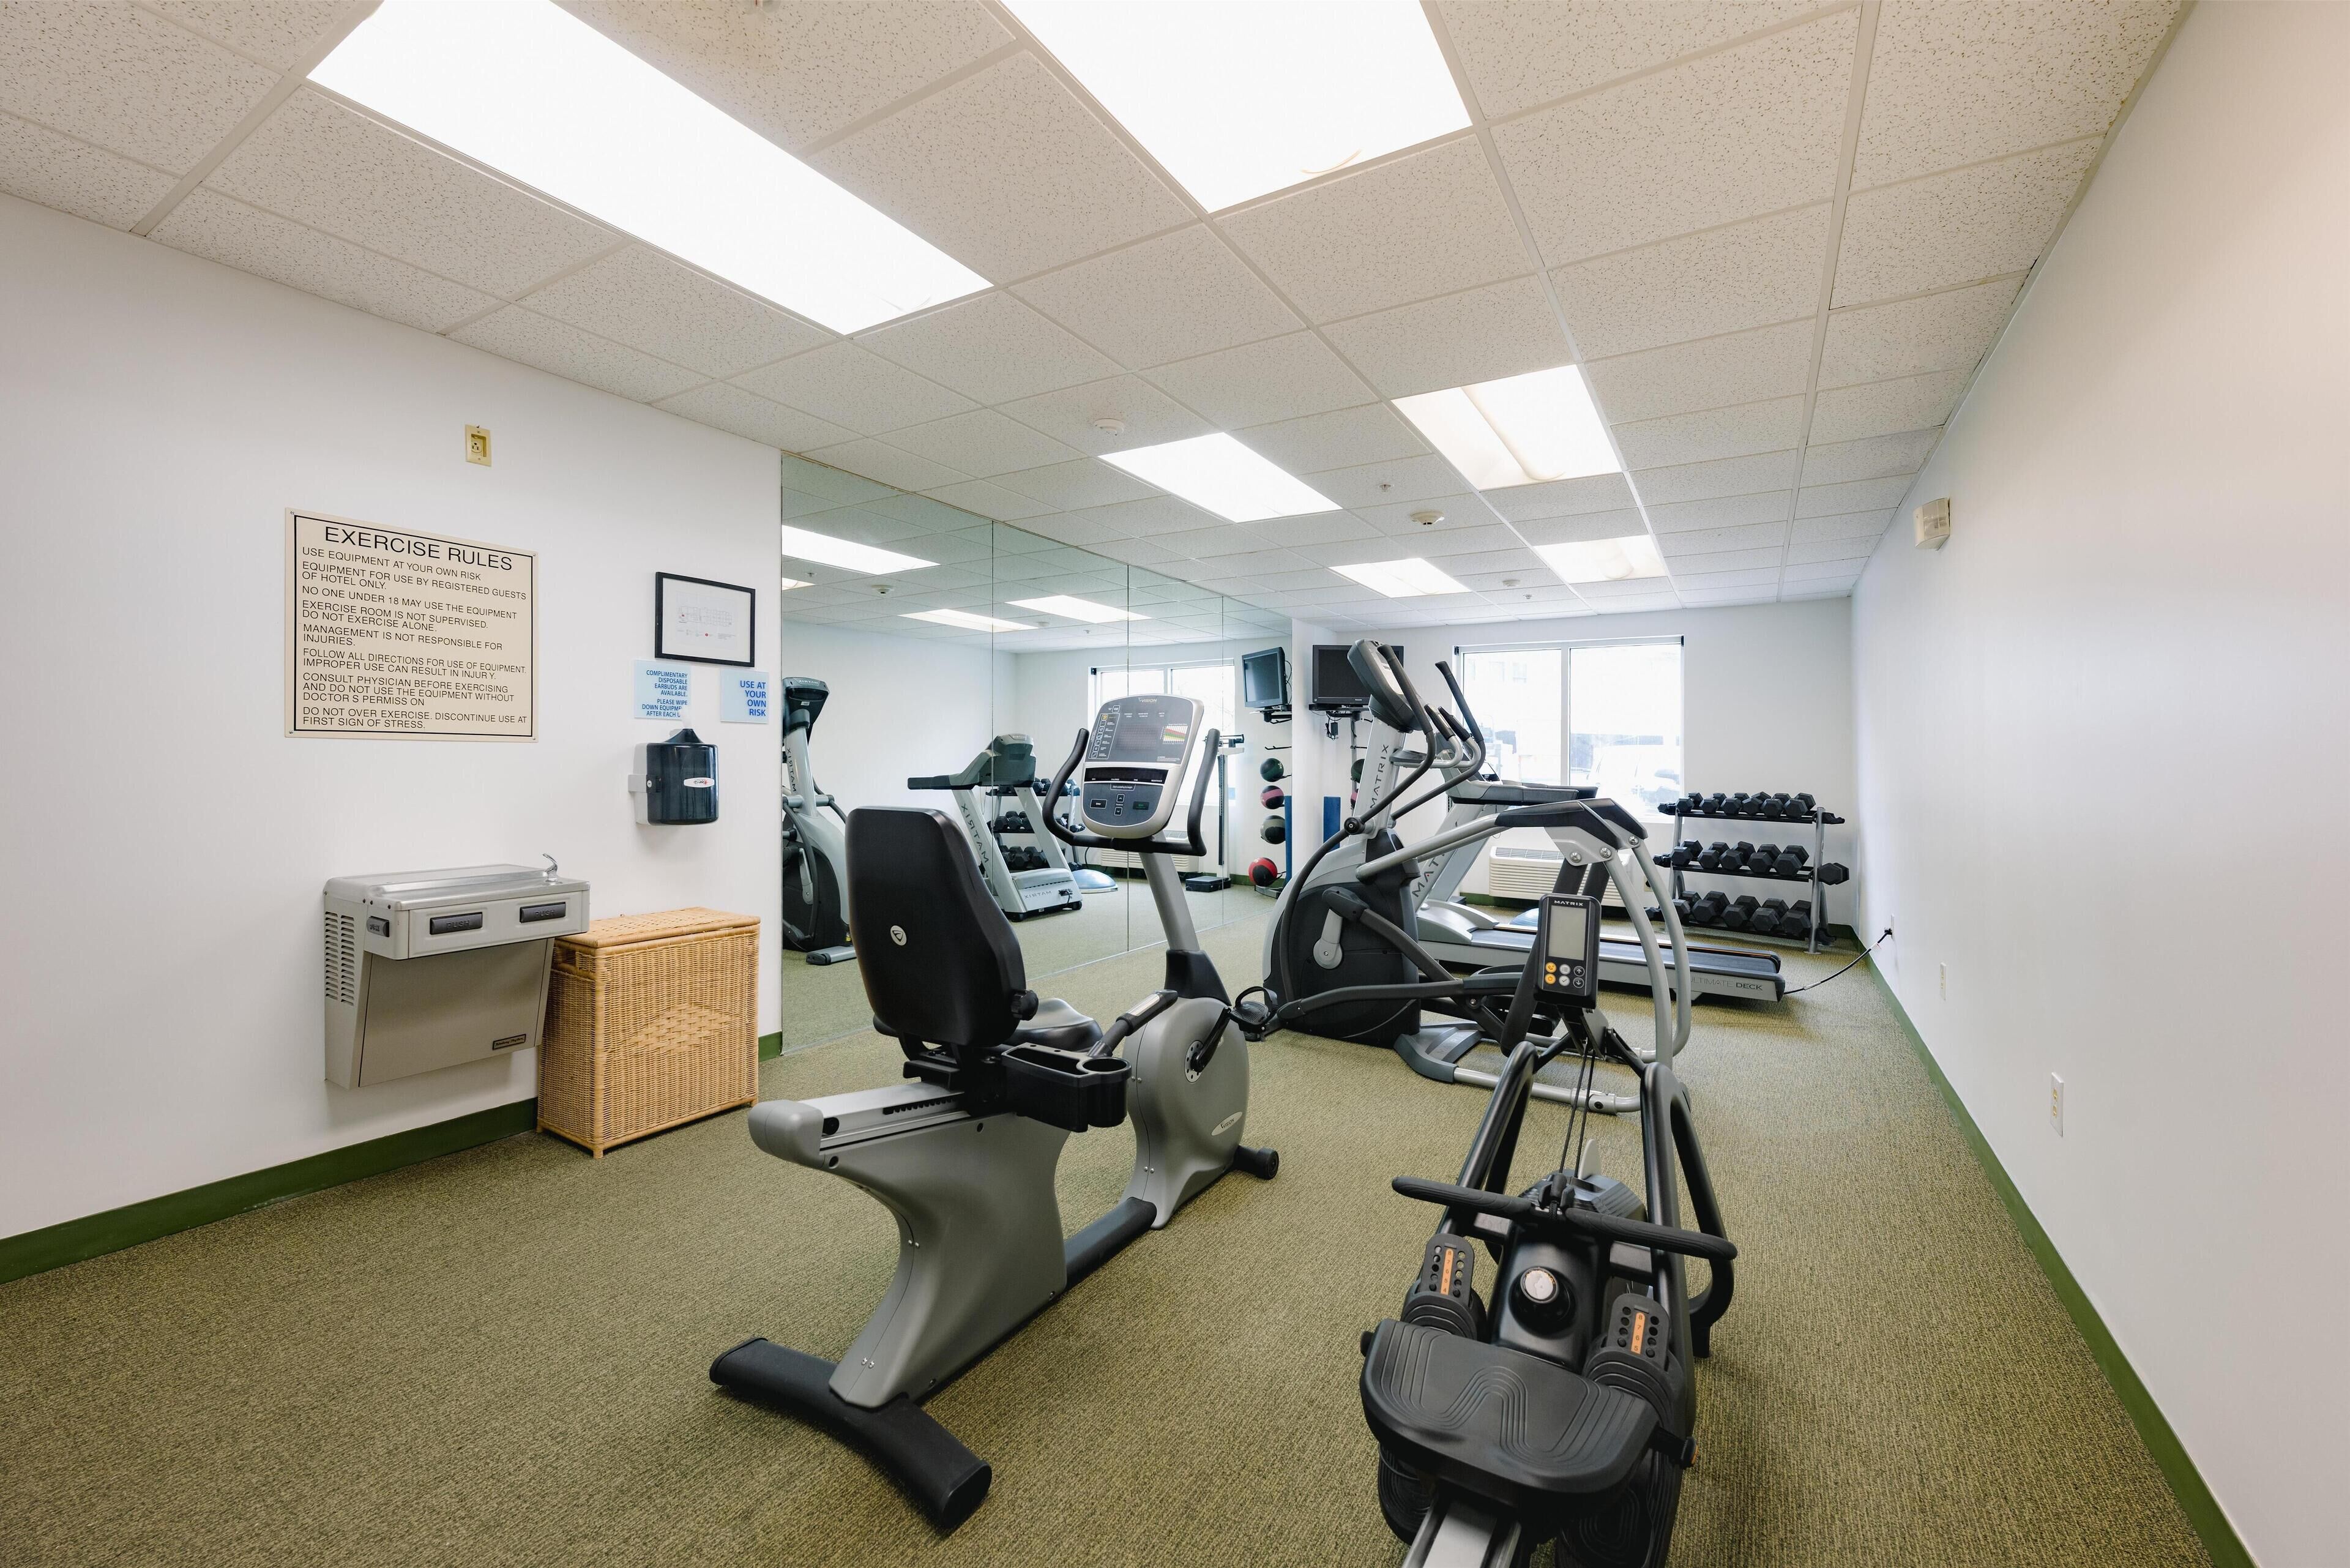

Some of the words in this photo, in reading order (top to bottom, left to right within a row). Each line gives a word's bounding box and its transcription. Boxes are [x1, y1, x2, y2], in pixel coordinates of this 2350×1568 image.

[325, 526, 441, 559] EXERCISE
[448, 547, 512, 571] RULES
[302, 547, 325, 558] USE
[329, 550, 390, 567] EQUIPMENT
[393, 560, 405, 569] AT
[406, 562, 433, 573] YOUR
[435, 567, 458, 577] OWN
[460, 570, 481, 581] RISK
[302, 561, 367, 577] EQUIPMENT
[370, 570, 390, 581] FOR
[394, 573, 413, 584] USE
[416, 577, 429, 586] BY
[431, 579, 490, 595] REGISTERED
[491, 588, 526, 600] GUESTS
[302, 571, 318, 580] OF
[321, 573, 357, 586] HOTEL
[359, 578, 387, 590] ONLY.
[302, 585, 319, 595] NO
[321, 588, 345, 599] ONE
[348, 591, 385, 603] UNDER
[389, 597, 399, 605] 18
[402, 598, 422, 608] MAY
[424, 601, 444, 610] USE
[445, 603, 464, 613] THE
[466, 606, 517, 619] EQUIPMENT
[302, 600, 357, 614] EXERCISE
[360, 607, 391, 618] ROOM
[395, 610, 404, 619] IS
[406, 611, 427, 621] NOT
[428, 614, 488, 629] SUPERVISED.
[302, 609, 319, 619] DO
[322, 611, 345, 622] NOT
[348, 614, 399, 628] EXERCISE
[401, 621, 437, 632] ALONE.
[303, 623, 379, 638] MANAGEMENT
[382, 631, 392, 640] IS
[395, 632, 416, 642] NOT
[418, 635, 482, 649] RESPONSIBLE
[485, 641, 502, 651] FOR
[304, 633, 356, 646] INJURIES.
[303, 648, 345, 659] FOLLOW
[348, 652, 365, 661] ALL
[368, 653, 424, 665] DIRECTIONS
[427, 658, 444, 667] FOR
[447, 660, 464, 669] USE
[480, 663, 526, 674] EQUIPMENT.
[303, 658, 360, 670] IMPROPER
[364, 662, 385, 672] USE
[387, 664, 408, 673] CAN
[411, 666, 447, 676] RESULT
[303, 672, 354, 684] CONSULT
[357, 676, 411, 687] PHYSICIAN
[414, 679, 452, 690] BEFORE
[455, 682, 509, 693] EXERCISING
[646, 670, 688, 678] COMPLIMENTARY
[302, 682, 326, 692] AND
[330, 684, 346, 693] DO
[349, 685, 371, 694] NOT
[373, 686, 394, 695] USE
[396, 687, 416, 696] THE
[419, 689, 473, 700] EQUIPMENT
[474, 692, 515, 702] WITHOUT
[740, 680, 755, 689] USE
[745, 690, 766, 698] YOUR
[747, 699, 766, 707] OWN
[749, 708, 766, 717] RISK
[303, 706, 319, 715] DO
[323, 707, 346, 716] NOT
[348, 708, 377, 718] OVER
[381, 709, 433, 720] EXERCISE.
[435, 712, 496, 722] DISCONTINUE
[303, 716, 335, 725] FIRST
[338, 717, 364, 726] SIGN
[367, 719, 381, 727] OF
[384, 719, 425, 729] STRESS.
[1370, 744, 1389, 808] MATRIX
[446, 919, 471, 929] PUSH
[1736, 982, 1763, 991] DECK
